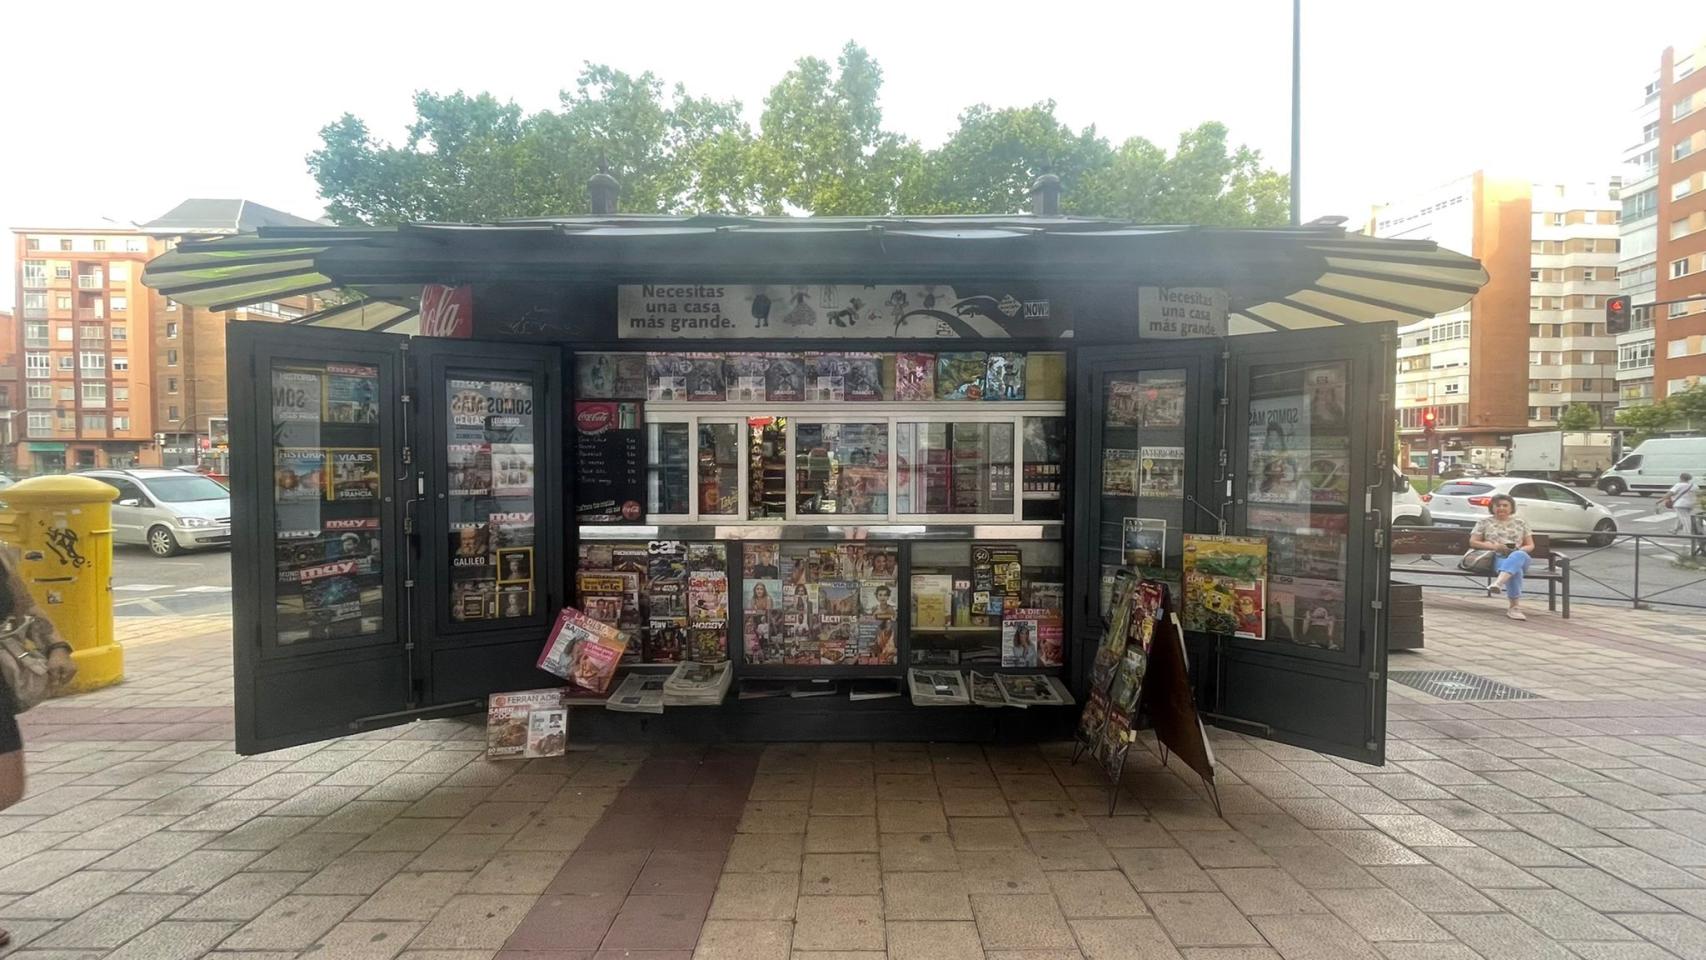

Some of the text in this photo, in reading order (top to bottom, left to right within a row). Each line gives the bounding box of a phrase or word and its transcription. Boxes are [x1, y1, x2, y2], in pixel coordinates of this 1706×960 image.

[642, 284, 725, 299] Necesitas
[1158, 288, 1212, 306] Necesitas
[646, 302, 721, 313] una casa
[1162, 306, 1211, 320] una casa
[630, 314, 736, 332] más grande.
[1149, 319, 1178, 332] más
[339, 453, 373, 462] VIAJES
[340, 490, 373, 498] FRANCIA
[648, 541, 680, 555] car
[453, 557, 485, 567] GALILEO
[300, 561, 355, 580] muy
[507, 695, 539, 704] FERRAN
